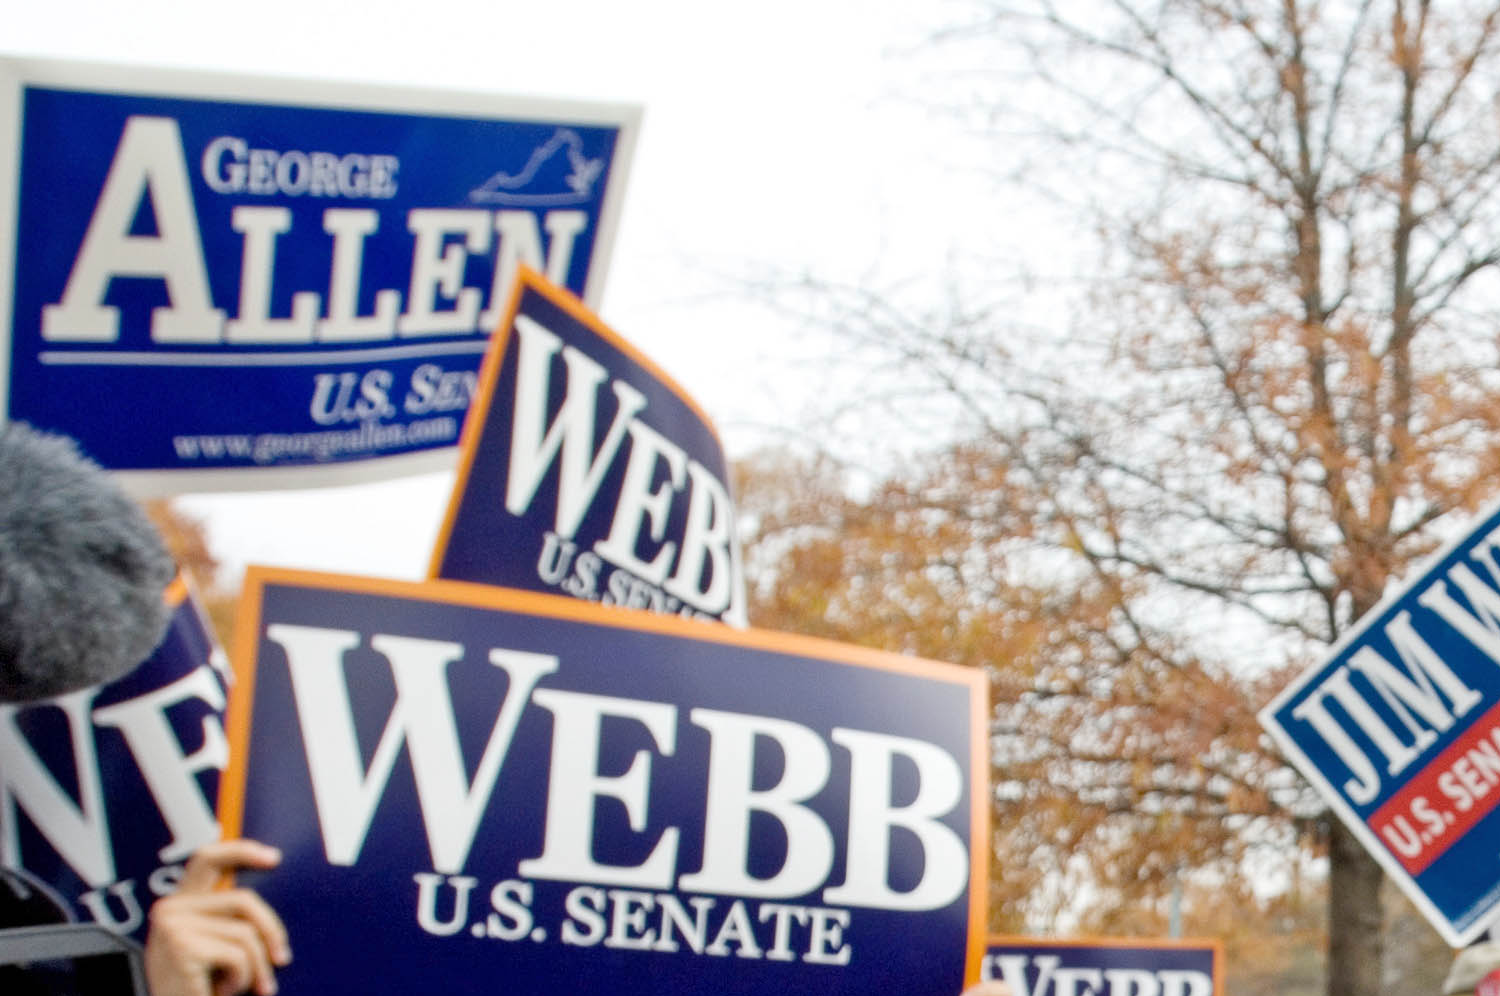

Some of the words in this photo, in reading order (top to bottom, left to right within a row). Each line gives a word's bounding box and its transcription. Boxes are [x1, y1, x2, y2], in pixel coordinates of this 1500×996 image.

[41, 115, 588, 344] ALLEN
[202, 136, 399, 199] GEORGE
[310, 369, 397, 425] U.S.
[404, 363, 479, 415] SEN
[505, 314, 749, 631] WEB
[266, 623, 969, 913] WEBB
[1293, 606, 1485, 807] JIM
[1381, 795, 1456, 860] U.S.
[413, 873, 547, 943] U.S.
[560, 888, 852, 967] SENATE
